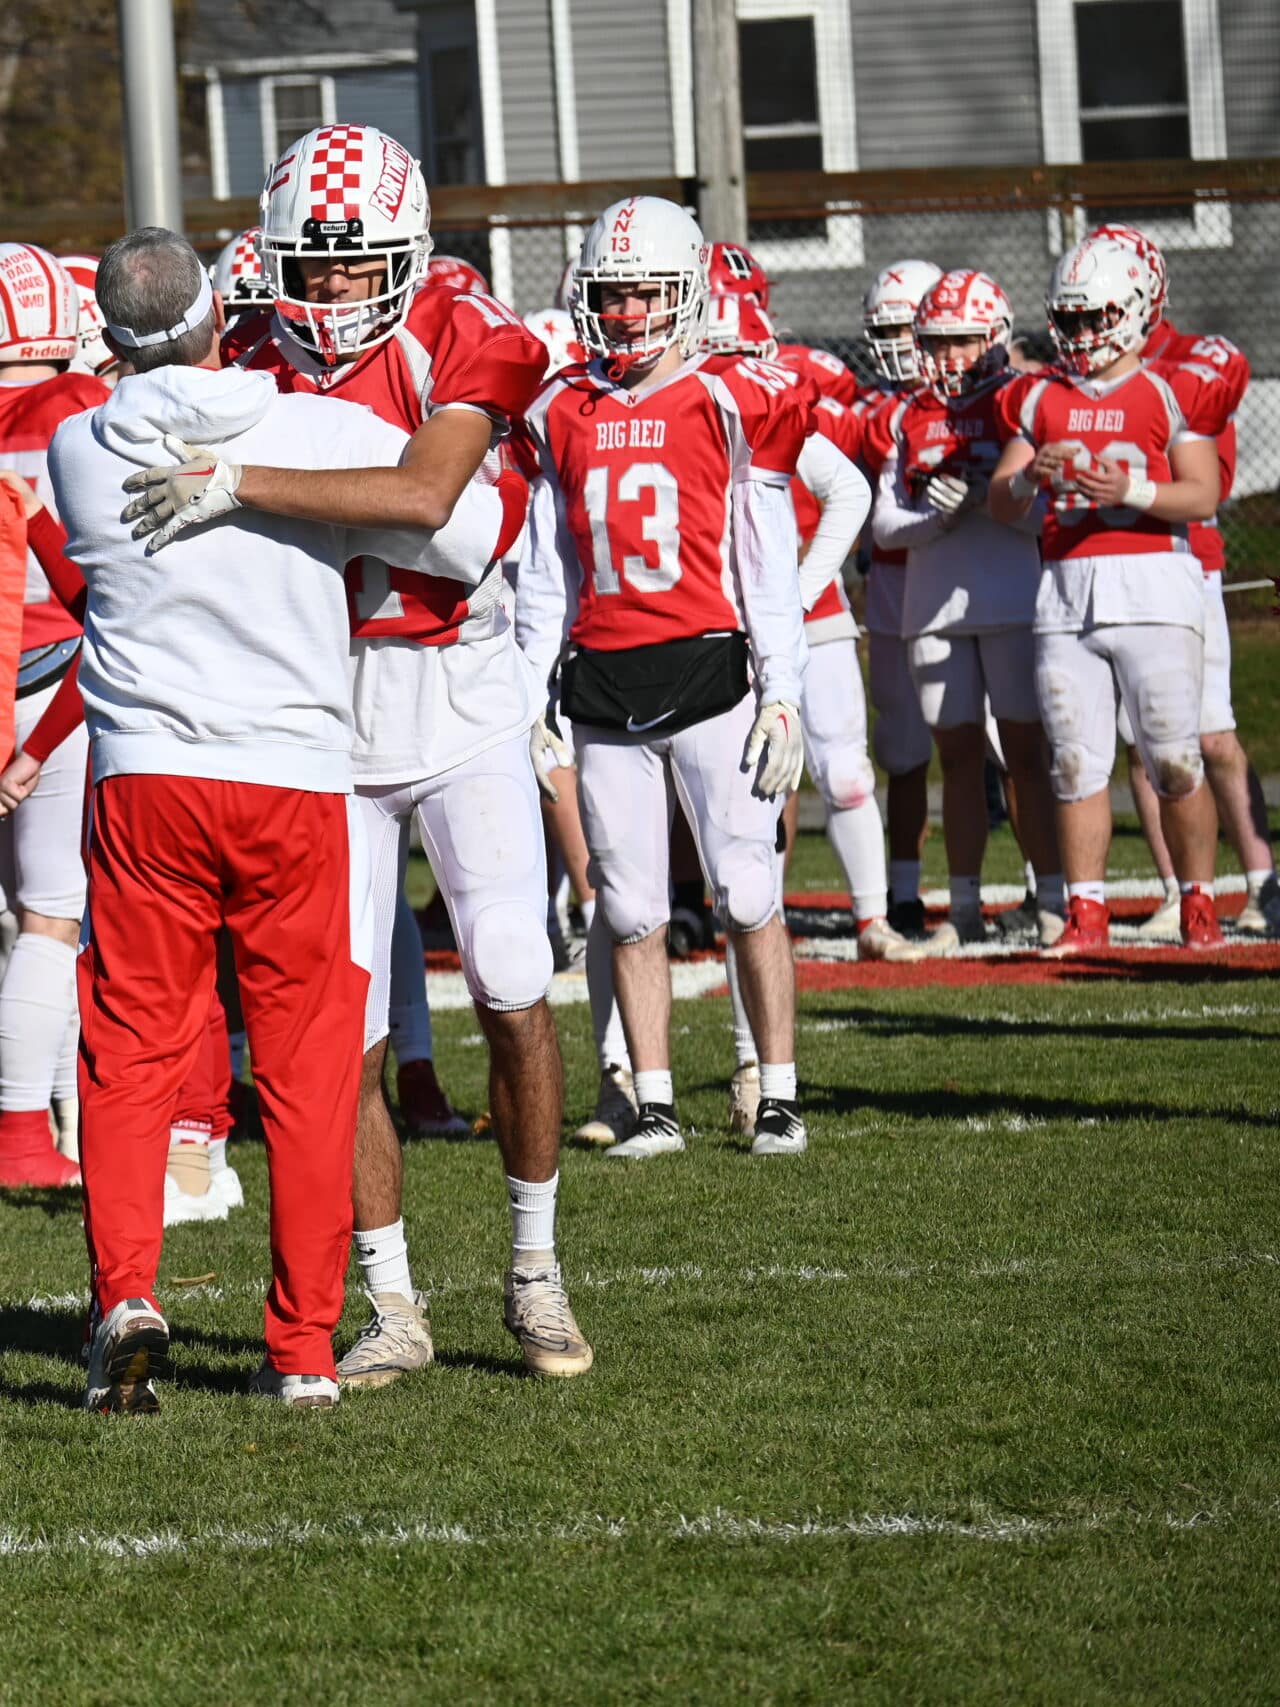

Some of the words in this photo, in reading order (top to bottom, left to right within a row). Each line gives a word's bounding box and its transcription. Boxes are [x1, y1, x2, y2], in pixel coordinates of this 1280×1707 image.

[611, 237, 630, 252] 13
[0, 251, 31, 270] MOM
[6, 262, 33, 280] DAD
[1067, 408, 1092, 432] BIG
[1095, 408, 1125, 432] RED
[595, 420, 627, 451] BIG
[629, 418, 667, 449] RED
[583, 462, 684, 596] 13
